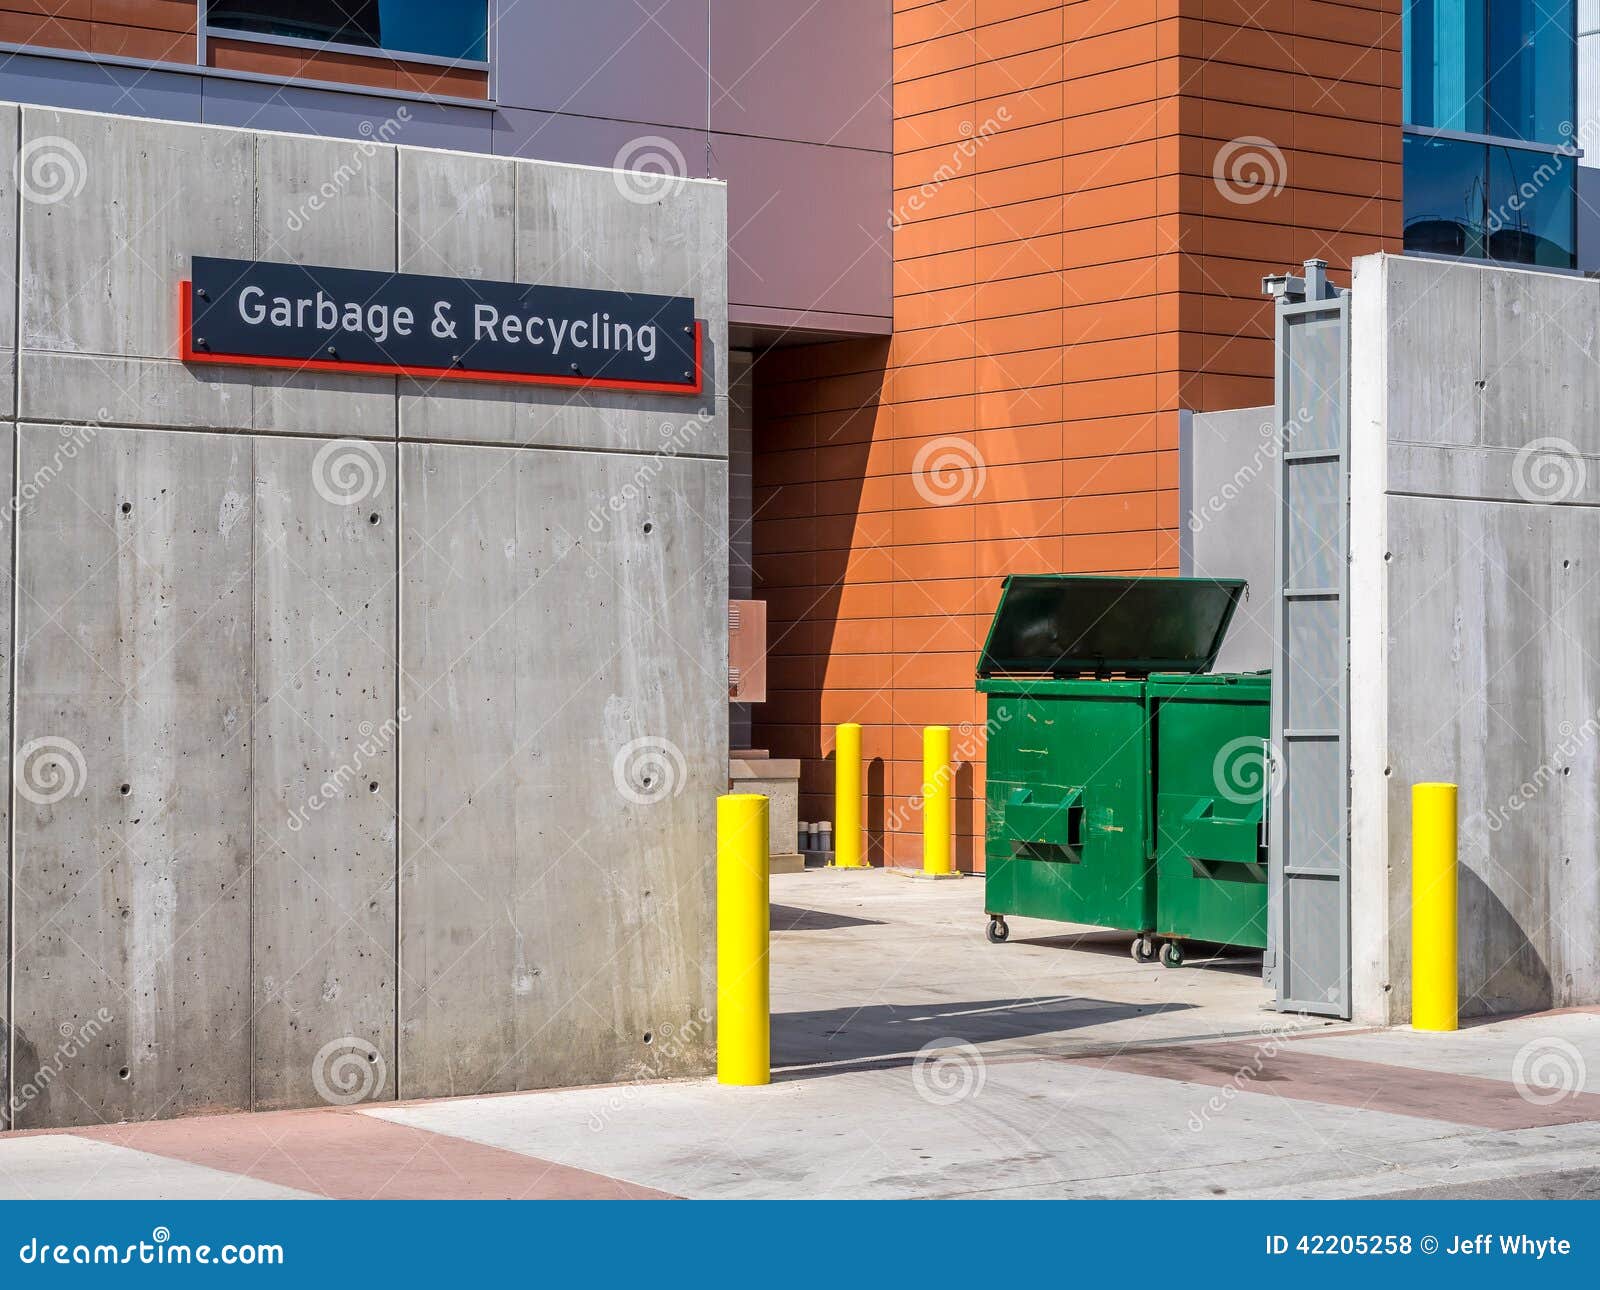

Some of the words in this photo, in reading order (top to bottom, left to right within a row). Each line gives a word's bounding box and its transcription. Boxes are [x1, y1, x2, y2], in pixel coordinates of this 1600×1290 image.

[238, 285, 414, 343] Garbage
[430, 300, 458, 339] &
[473, 303, 657, 362] Recycling
